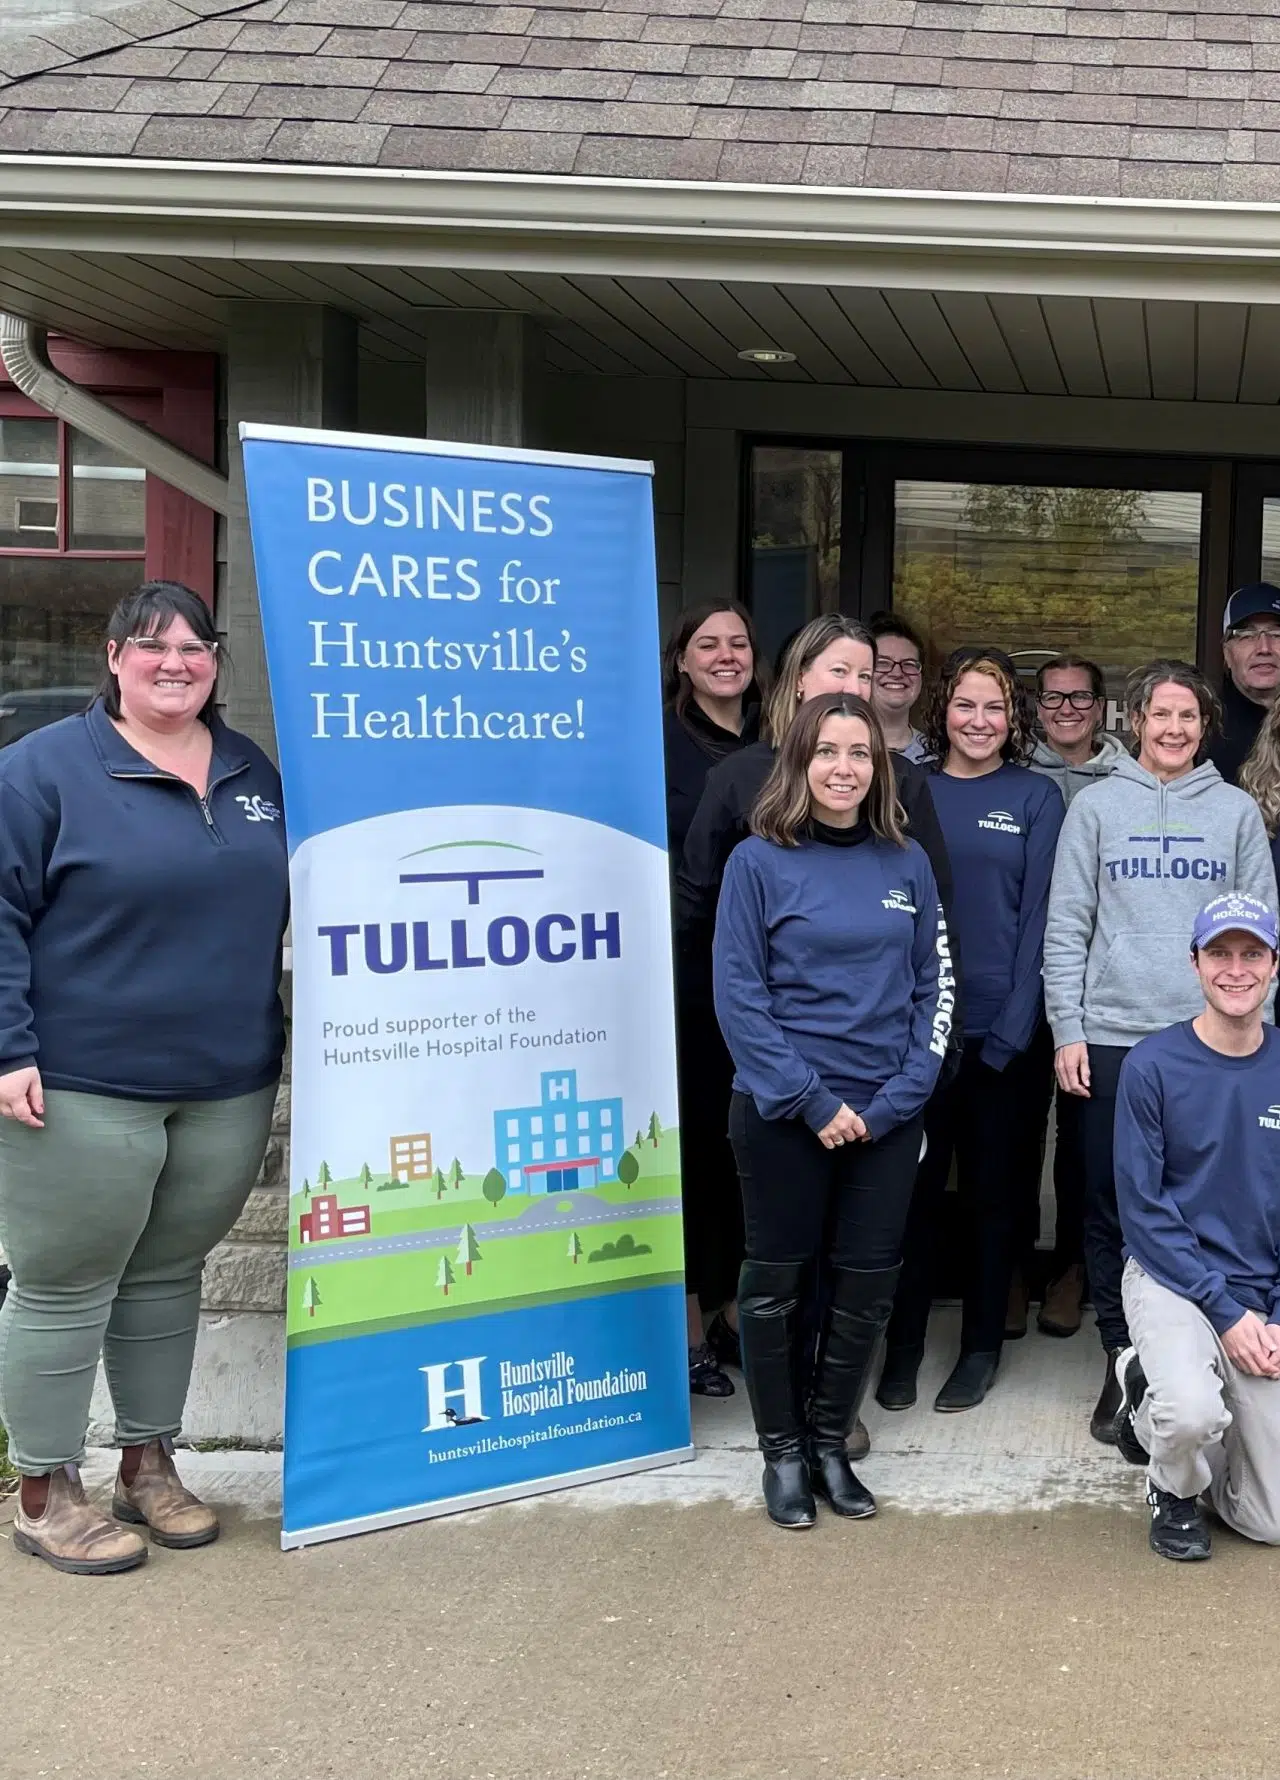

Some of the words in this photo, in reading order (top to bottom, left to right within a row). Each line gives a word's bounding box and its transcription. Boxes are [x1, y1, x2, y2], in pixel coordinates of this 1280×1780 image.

[306, 476, 554, 537] BUSINESS
[308, 549, 481, 601] CARES
[499, 559, 561, 605] for
[308, 620, 588, 673] Huntsville's
[310, 692, 586, 740] Healthcare!
[977, 819, 1021, 834] TULLOCH
[1105, 857, 1227, 882] TULLOCH
[1212, 910, 1260, 922] HOCKEY
[317, 910, 622, 977] TULLOCH
[322, 1017, 379, 1039] Proud
[385, 1012, 477, 1036] supporter
[484, 1008, 502, 1026] of
[508, 1006, 537, 1023] the
[323, 1040, 421, 1067] Huntsville
[426, 1033, 503, 1058] Hospital
[509, 1027, 608, 1050] Foundation
[500, 1351, 575, 1388] Huntsville
[501, 1378, 564, 1417] Hospital
[566, 1367, 648, 1405] Foundation
[428, 1411, 643, 1464] huntsvillehospitalfoundation.ca
